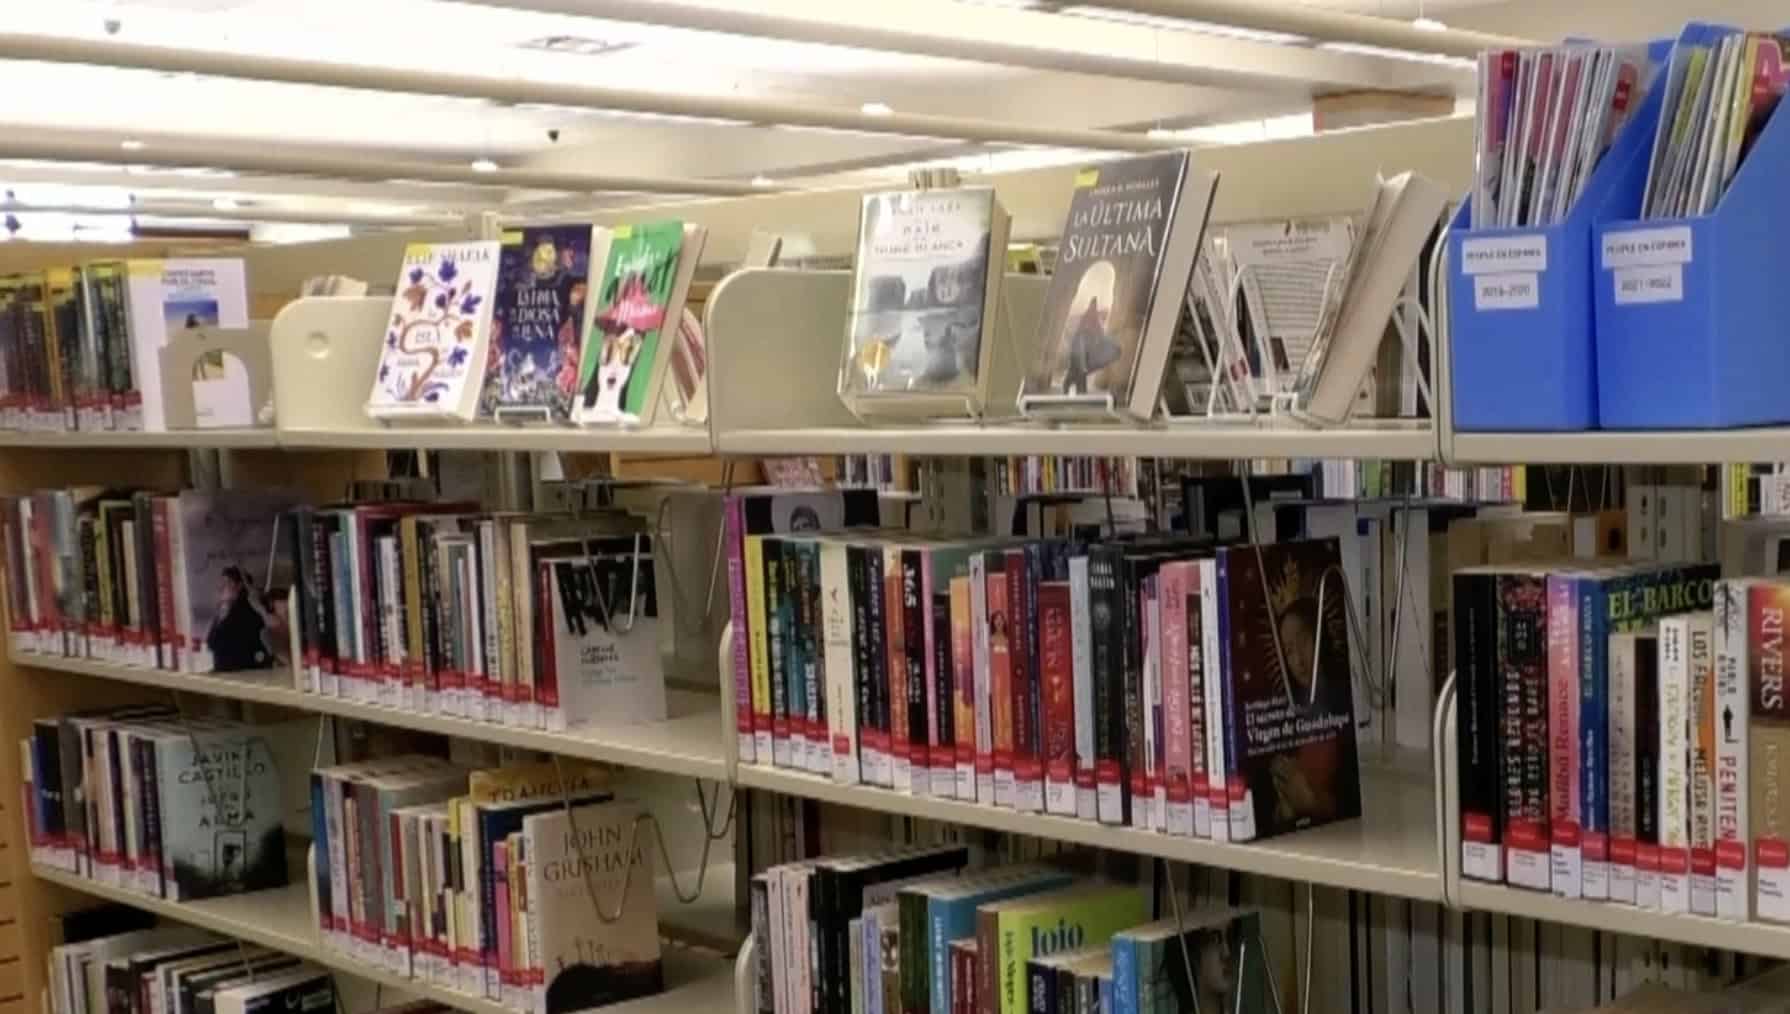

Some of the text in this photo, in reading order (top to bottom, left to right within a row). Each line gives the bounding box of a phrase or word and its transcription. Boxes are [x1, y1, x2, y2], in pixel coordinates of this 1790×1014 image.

[1073, 211, 1088, 227] LA
[1063, 226, 1155, 264] SULTANA
[903, 563, 917, 608] 365
[1608, 591, 1632, 619] EL
[1644, 578, 1713, 614] BARCO
[1692, 631, 1708, 659] LOS
[1760, 608, 1784, 709] RIVERS
[1247, 711, 1351, 743] Virgen de Guadalupe
[178, 761, 265, 784] CASTILLO
[1719, 756, 1738, 840] PENITEN
[563, 823, 621, 857] JOHN
[544, 848, 642, 881] GRISHAM
